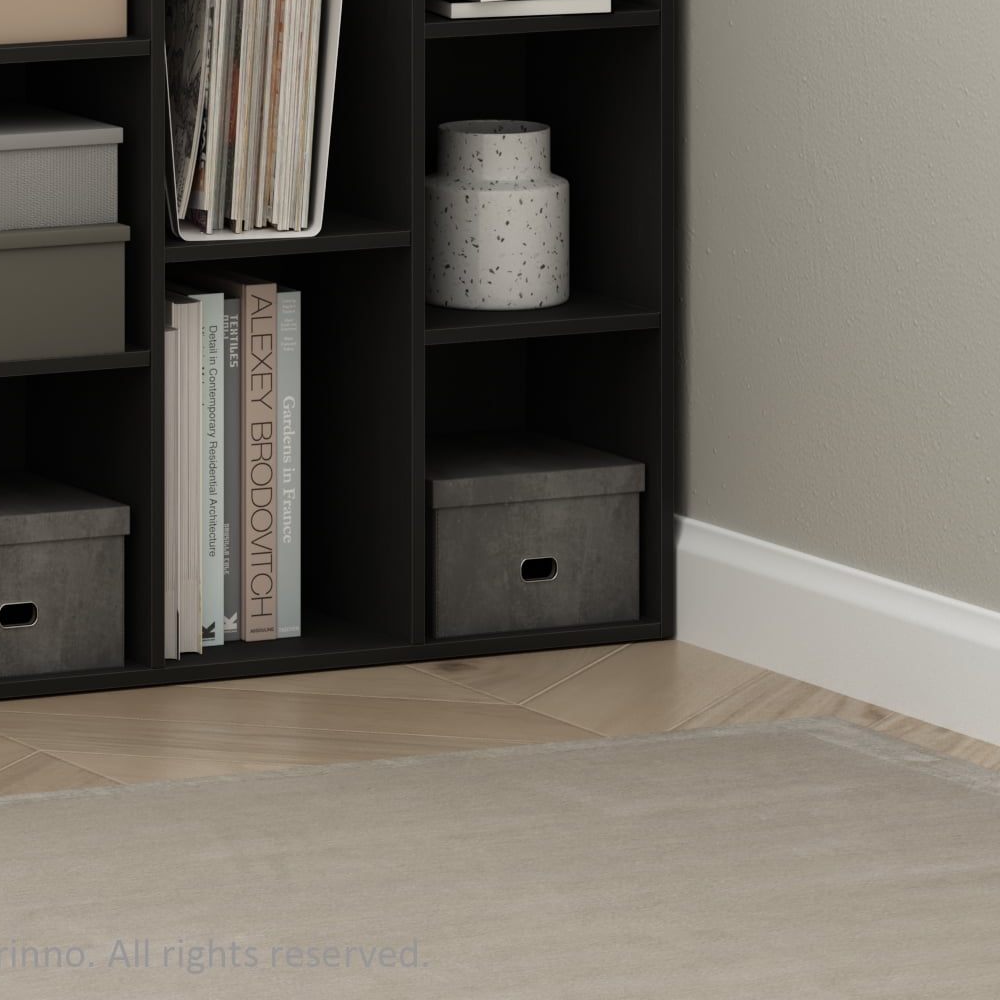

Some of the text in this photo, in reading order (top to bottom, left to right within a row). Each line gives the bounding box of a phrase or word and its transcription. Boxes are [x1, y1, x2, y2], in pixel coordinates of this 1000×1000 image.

[229, 313, 239, 368] TEXTILES
[207, 325, 218, 557] Detail in Contemporary Residential Architecture
[250, 294, 274, 618] ALEXEY BRODOVITCH
[282, 395, 296, 544] Gardens in France
